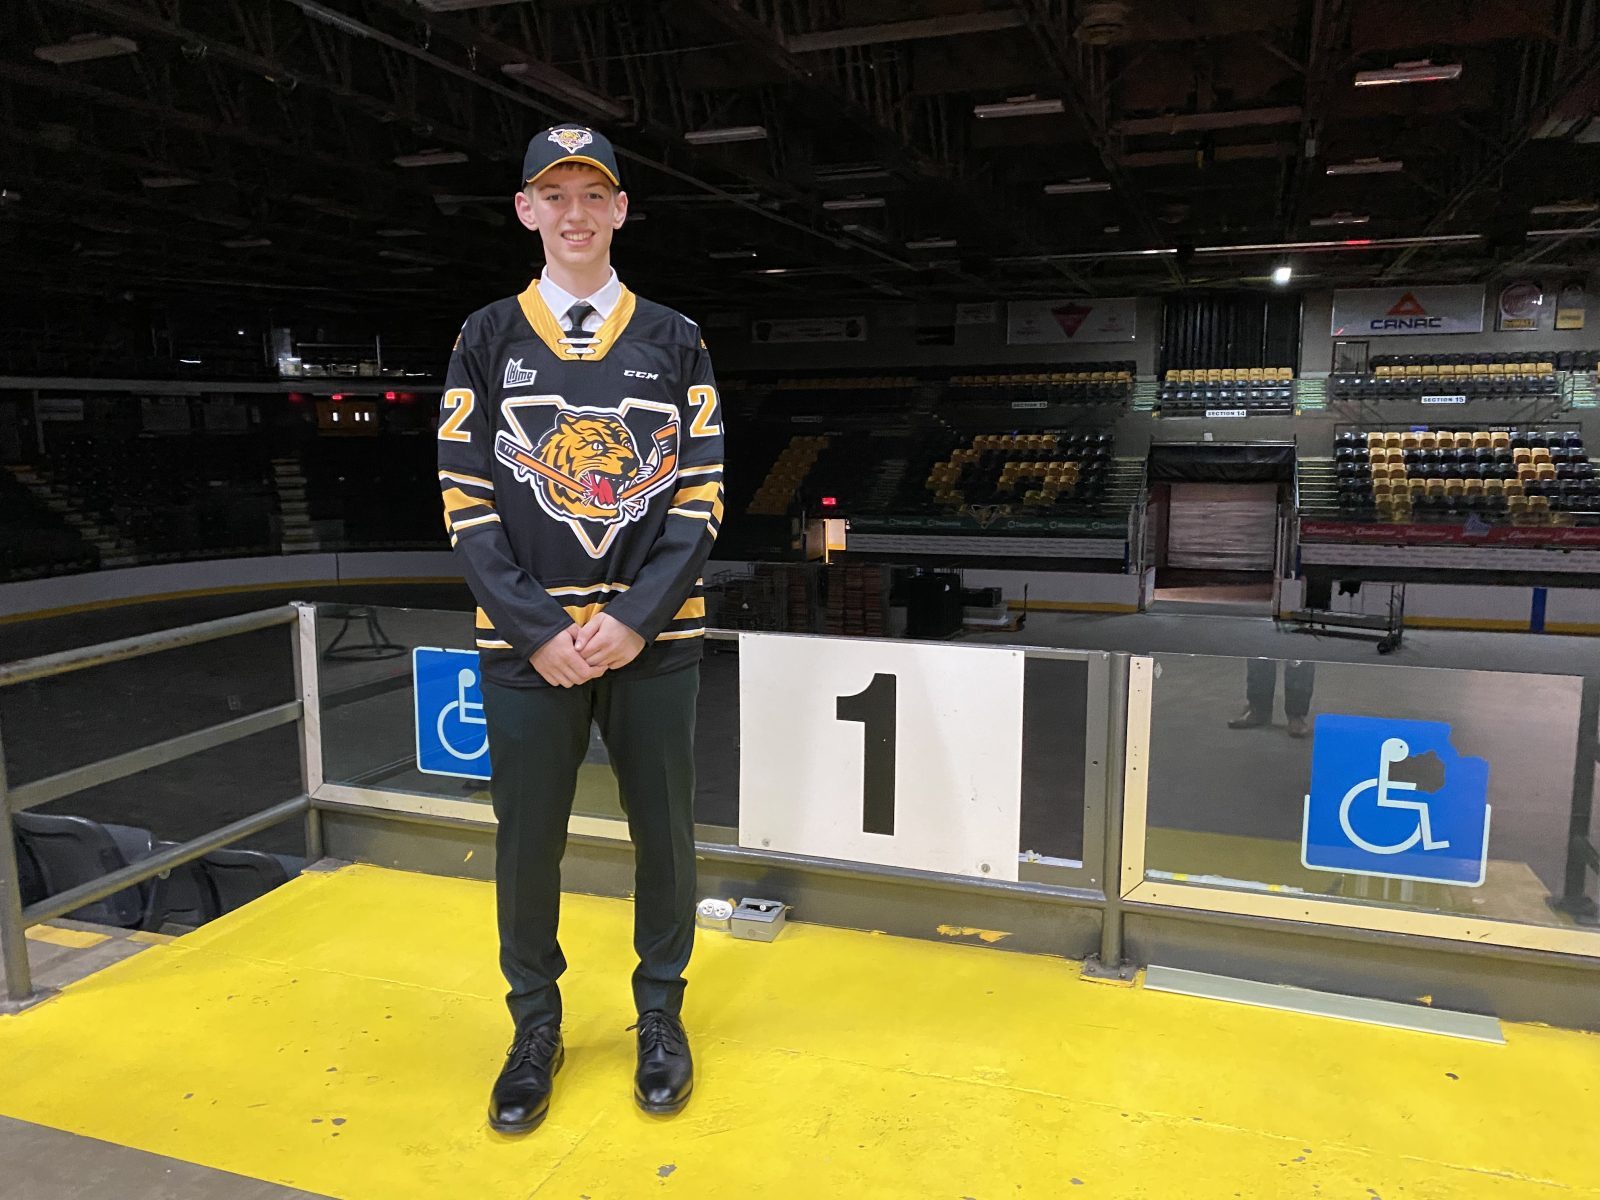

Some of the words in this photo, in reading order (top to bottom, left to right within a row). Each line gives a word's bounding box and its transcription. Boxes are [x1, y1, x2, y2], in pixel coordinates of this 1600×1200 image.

[1370, 317, 1442, 330] CANAC
[623, 369, 659, 380] CCM
[836, 672, 896, 836] 1
